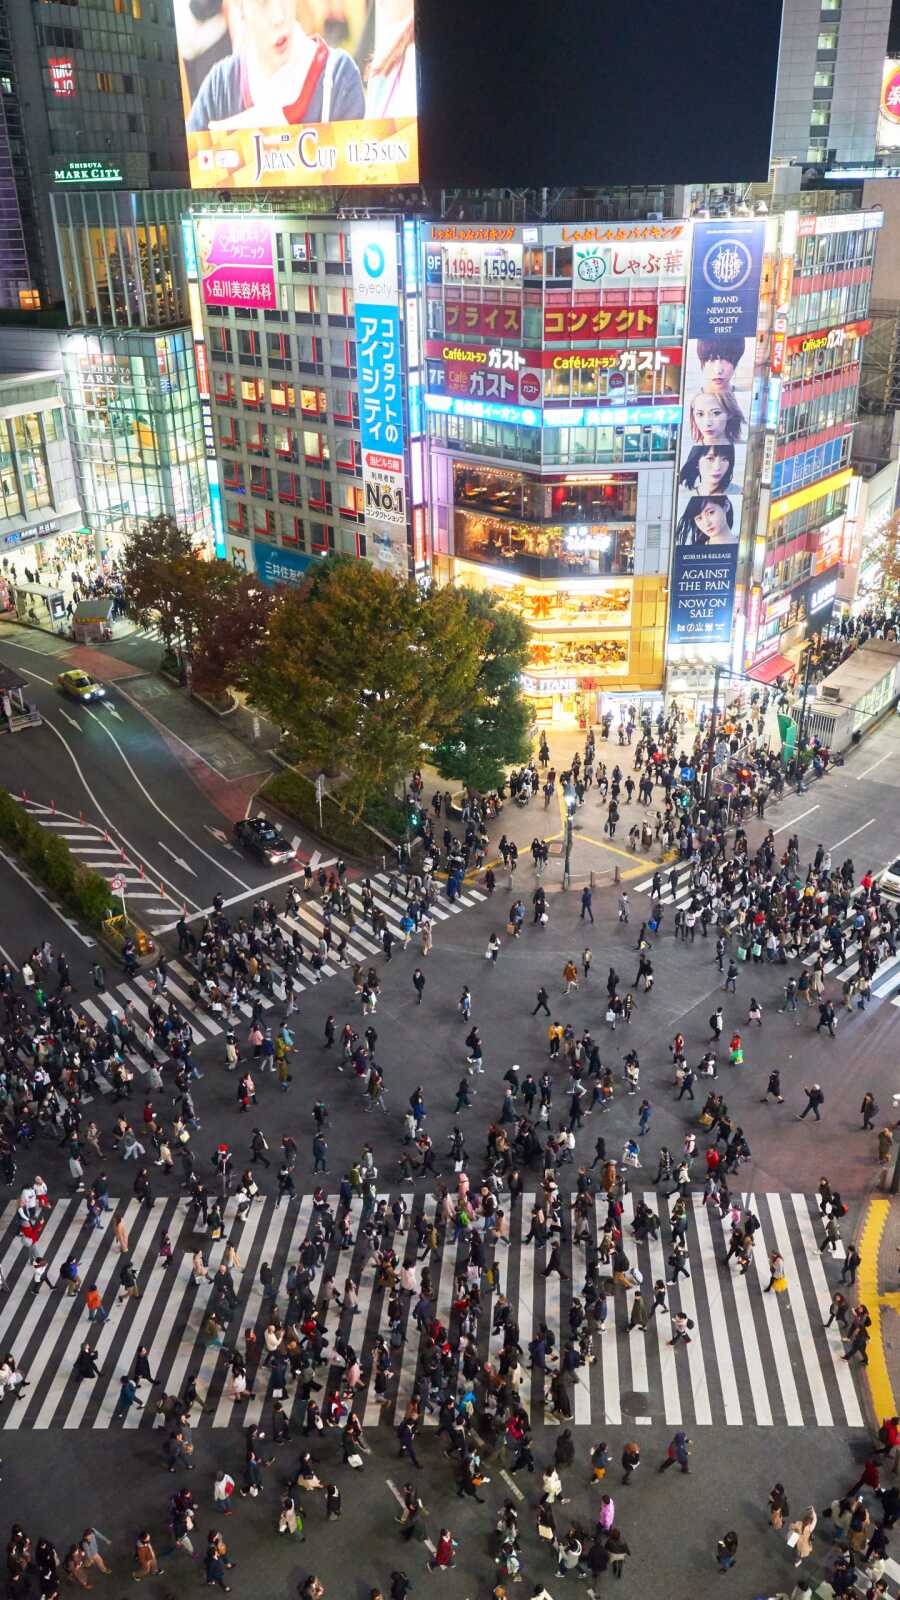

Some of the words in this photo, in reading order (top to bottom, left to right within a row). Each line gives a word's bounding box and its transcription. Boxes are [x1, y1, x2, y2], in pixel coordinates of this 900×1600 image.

[380, 143, 407, 161] SUN
[54, 170, 88, 180] MARK
[91, 168, 120, 178] CITY
[427, 255, 441, 270] 9F
[612, 249, 684, 274] しゃぶ葉
[212, 280, 272, 300] 品川美容外科
[713, 295, 739, 304] BRAND
[706, 306, 725, 314] NEW
[725, 305, 743, 314] IDOL
[544, 309, 654, 333] コンタクト
[708, 316, 739, 325] SOCIETY
[714, 326, 733, 334] FIRST
[488, 347, 527, 371] ガスト
[618, 350, 670, 371] ガスト
[360, 317, 381, 441] アイシティ
[381, 319, 398, 443] コンタクトの
[429, 369, 445, 385] 7F
[469, 371, 514, 399] ガスト
[522, 385, 539, 394] ガスト
[365, 482, 404, 514] No.1
[681, 568, 730, 580] AGAINST
[678, 580, 701, 591] THE
[704, 580, 730, 591] PAIN
[678, 598, 708, 608] NOW
[708, 598, 728, 608] ON
[689, 608, 714, 618] SALE
